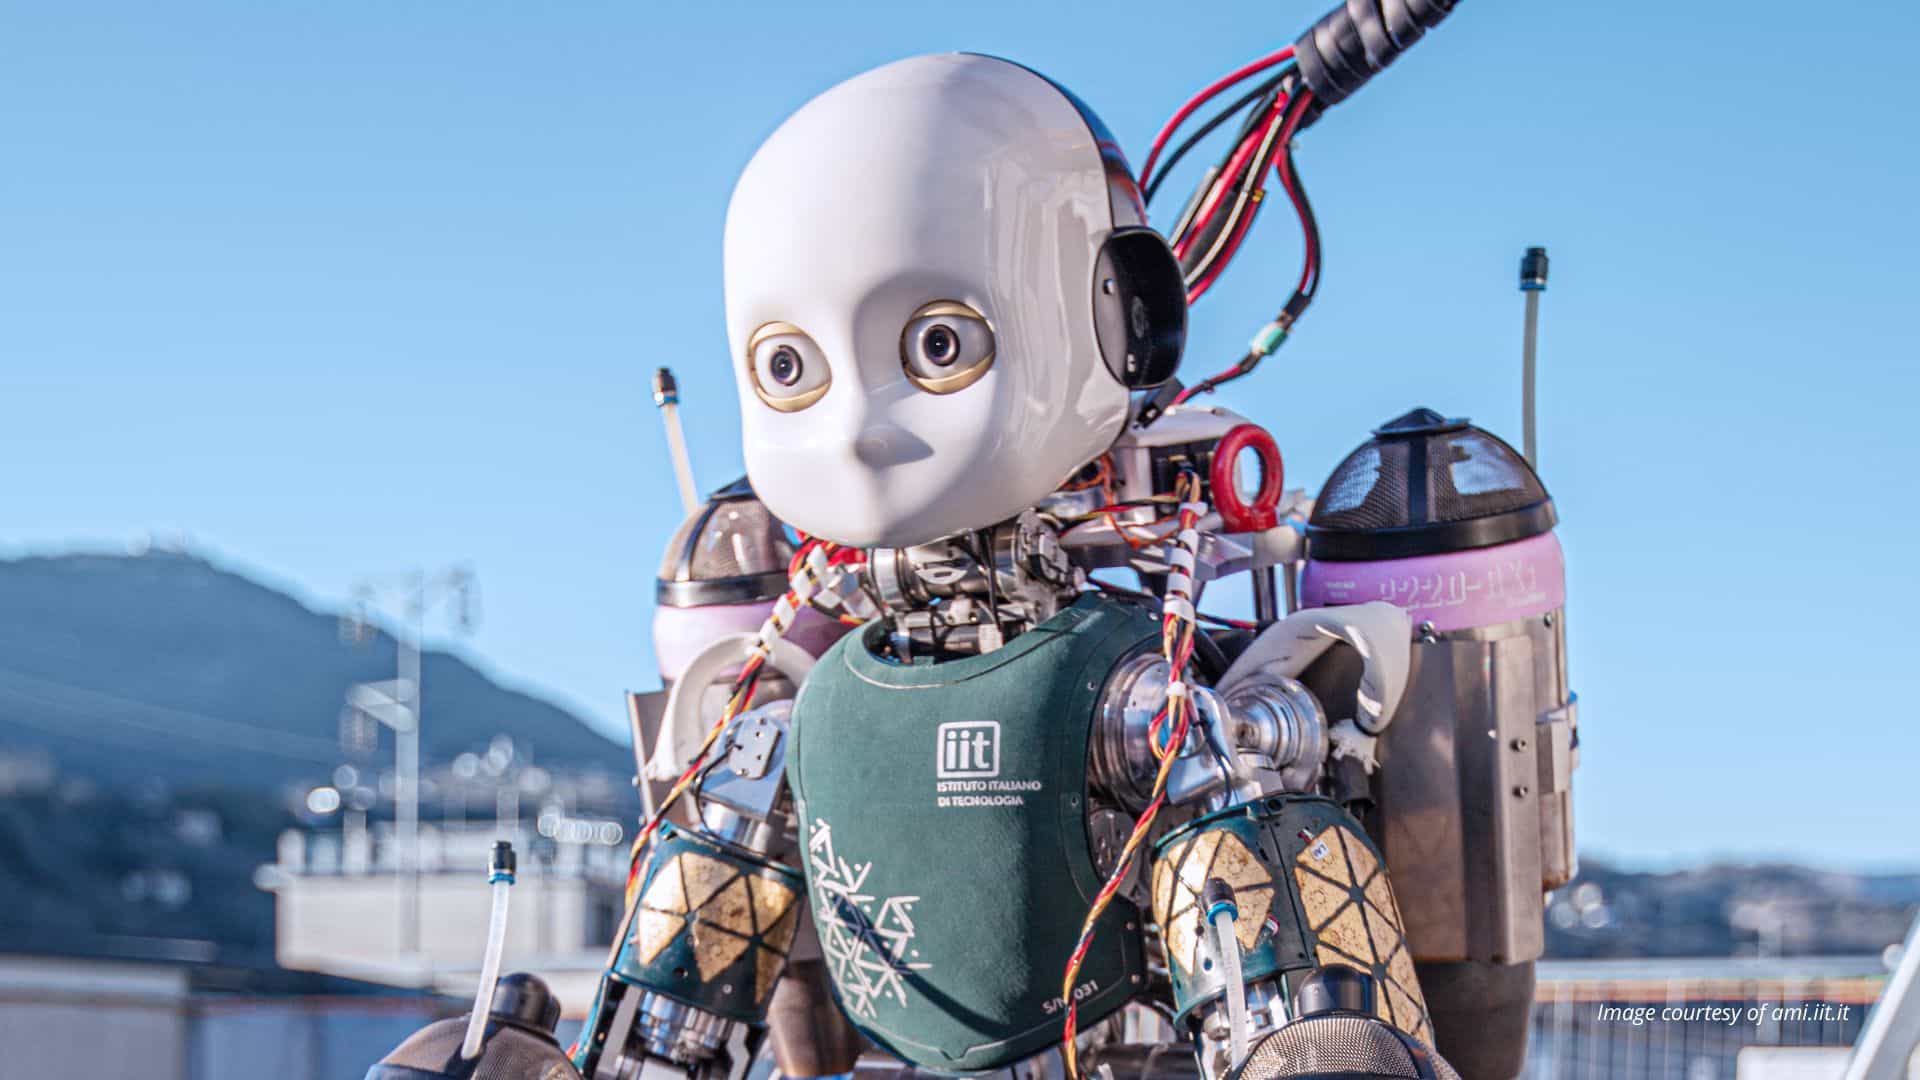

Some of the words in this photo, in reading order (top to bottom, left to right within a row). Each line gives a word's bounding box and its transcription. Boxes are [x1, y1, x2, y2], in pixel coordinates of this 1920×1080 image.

[946, 730, 990, 769] iit
[937, 781, 987, 792] ISTITUTO
[988, 780, 1041, 791] ITALIANO
[938, 797, 950, 807] DI
[951, 795, 1024, 806] TECNOLOGIA
[1074, 980, 1098, 999] 031
